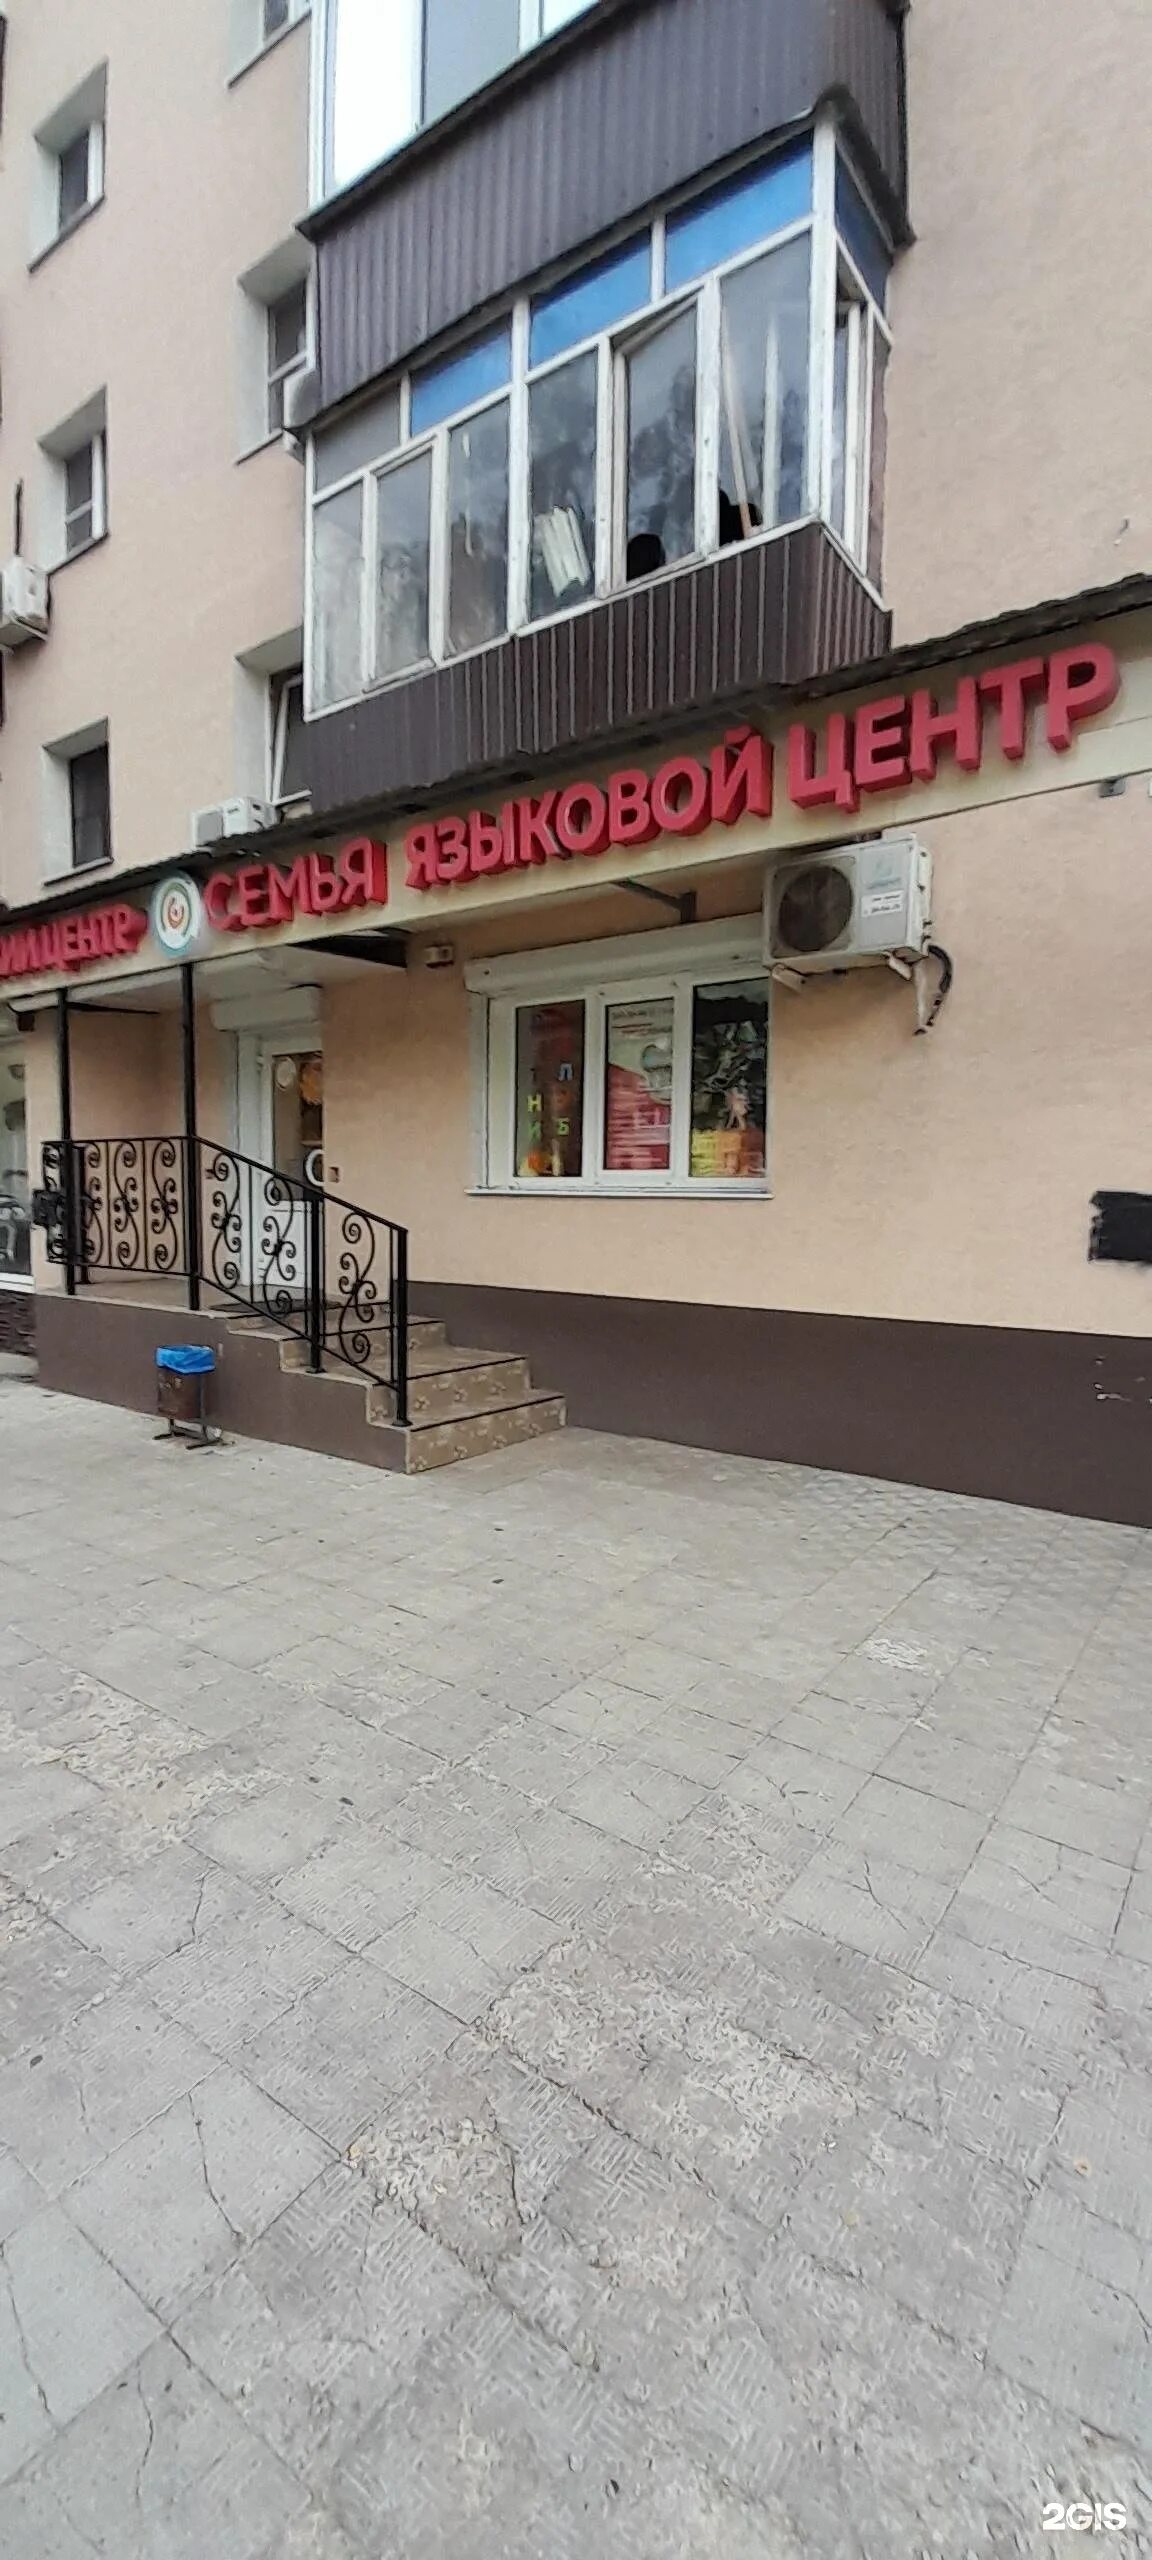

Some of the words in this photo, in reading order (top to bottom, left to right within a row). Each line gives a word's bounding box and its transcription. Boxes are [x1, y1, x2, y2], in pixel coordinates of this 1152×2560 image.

[405, 726, 774, 891] ЯЗЫКОВОЙ
[787, 642, 1121, 814] ЦЕНТР
[204, 837, 388, 932] СЕМЬЯ
